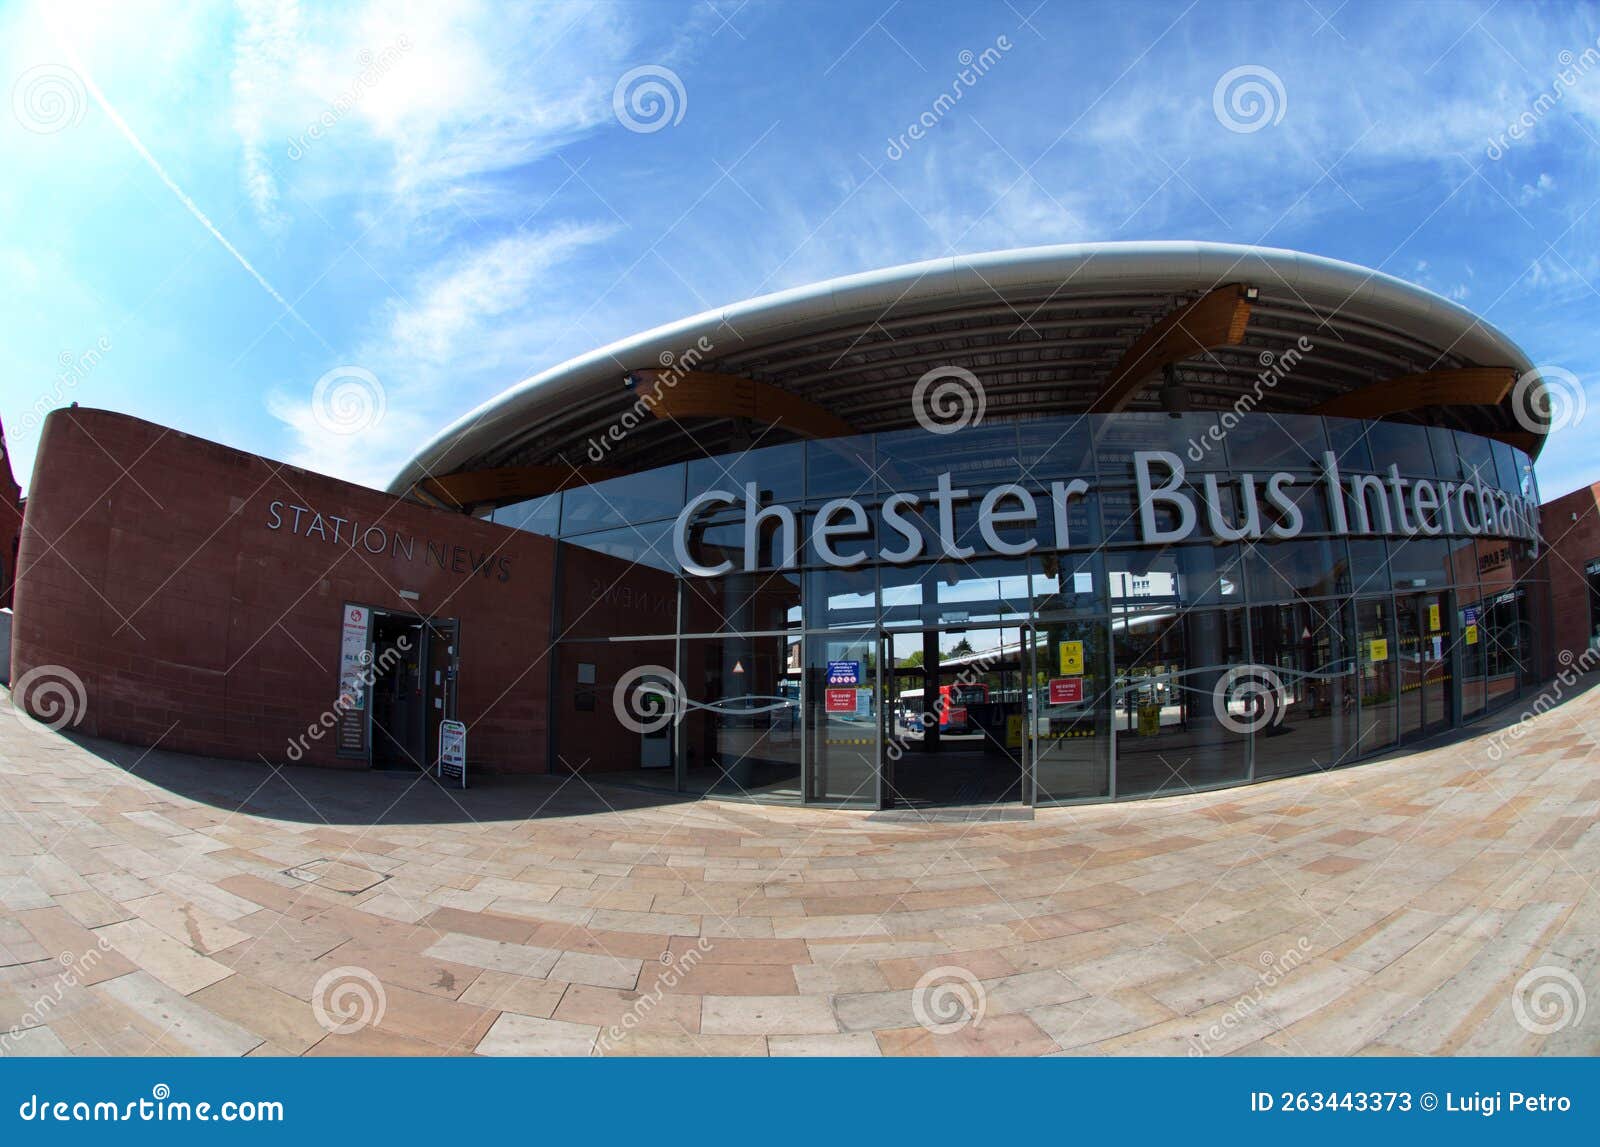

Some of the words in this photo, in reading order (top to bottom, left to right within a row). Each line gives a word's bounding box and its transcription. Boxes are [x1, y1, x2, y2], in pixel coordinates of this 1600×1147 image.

[267, 500, 414, 561] STATION
[425, 540, 511, 583] NEWS
[673, 477, 1089, 578] Chester
[1133, 451, 1303, 545] Bus
[1324, 451, 1540, 559] Interchang
